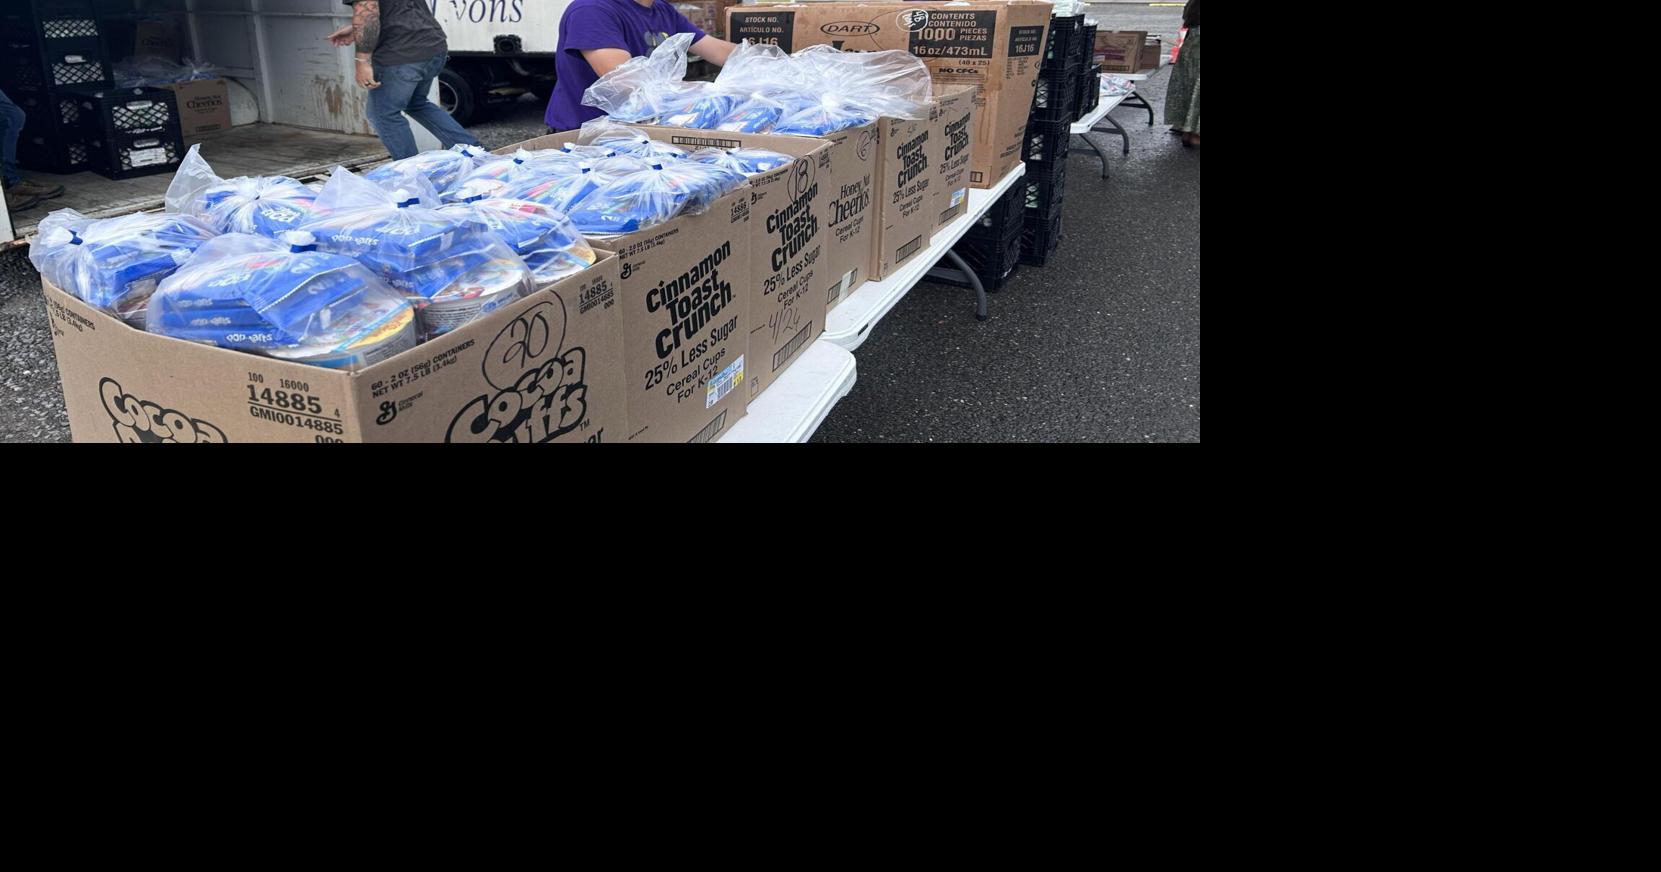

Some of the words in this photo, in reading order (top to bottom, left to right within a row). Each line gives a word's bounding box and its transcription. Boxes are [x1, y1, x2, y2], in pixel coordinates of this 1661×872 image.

[431, 0, 523, 23] yons
[827, 25, 872, 33] DART
[917, 28, 955, 41] 1000
[913, 46, 926, 55] 16
[929, 46, 988, 56] oz/473mL
[945, 112, 970, 136] Cinnamon
[951, 124, 967, 146] Toast
[897, 130, 929, 159] Cinnamon
[903, 145, 923, 170] Toast
[945, 132, 969, 161] Crunch
[794, 159, 808, 202] 18
[898, 154, 927, 188] Crunch
[841, 182, 862, 200] Honey
[905, 185, 916, 198] Less
[766, 182, 818, 234] Cinnamon
[828, 190, 870, 227] Cheerios
[654, 228, 679, 240] CONTAINERS
[779, 204, 811, 246] Toast
[771, 214, 818, 273] Crunch
[646, 240, 731, 313] Cinnamon
[763, 272, 785, 295] 25%
[787, 260, 802, 281] Less
[804, 245, 821, 268] Sugar
[778, 283, 798, 303] Cereal
[800, 270, 813, 286] Cups
[579, 280, 607, 304] 14885
[666, 269, 718, 325] Toast
[784, 297, 795, 310] For
[796, 283, 809, 298] K-12
[65, 308, 96, 331] CONTAINERS
[656, 280, 732, 359] Crunch
[503, 310, 549, 368] 20
[645, 356, 677, 390] 25%
[681, 340, 707, 368] Less
[710, 315, 738, 346] Sugar
[247, 372, 264, 383] 100
[371, 381, 383, 391] 60
[398, 369, 409, 379] OZ
[411, 360, 431, 373] (56g)
[432, 339, 475, 363] CONTAINERS
[372, 386, 389, 398] NET
[391, 380, 404, 390] WT
[407, 374, 419, 384] 7.5
[420, 368, 431, 378] LB
[432, 356, 457, 373] (3.4kg)
[666, 366, 700, 396] Cereal
[703, 347, 726, 376] Cups
[280, 379, 309, 392] 16000
[443, 346, 586, 443] Cocoa
[677, 386, 695, 403] For
[698, 365, 718, 388] K-12
[246, 384, 322, 414] 14885
[334, 408, 341, 418] 4
[249, 405, 344, 435] GMI0014885
